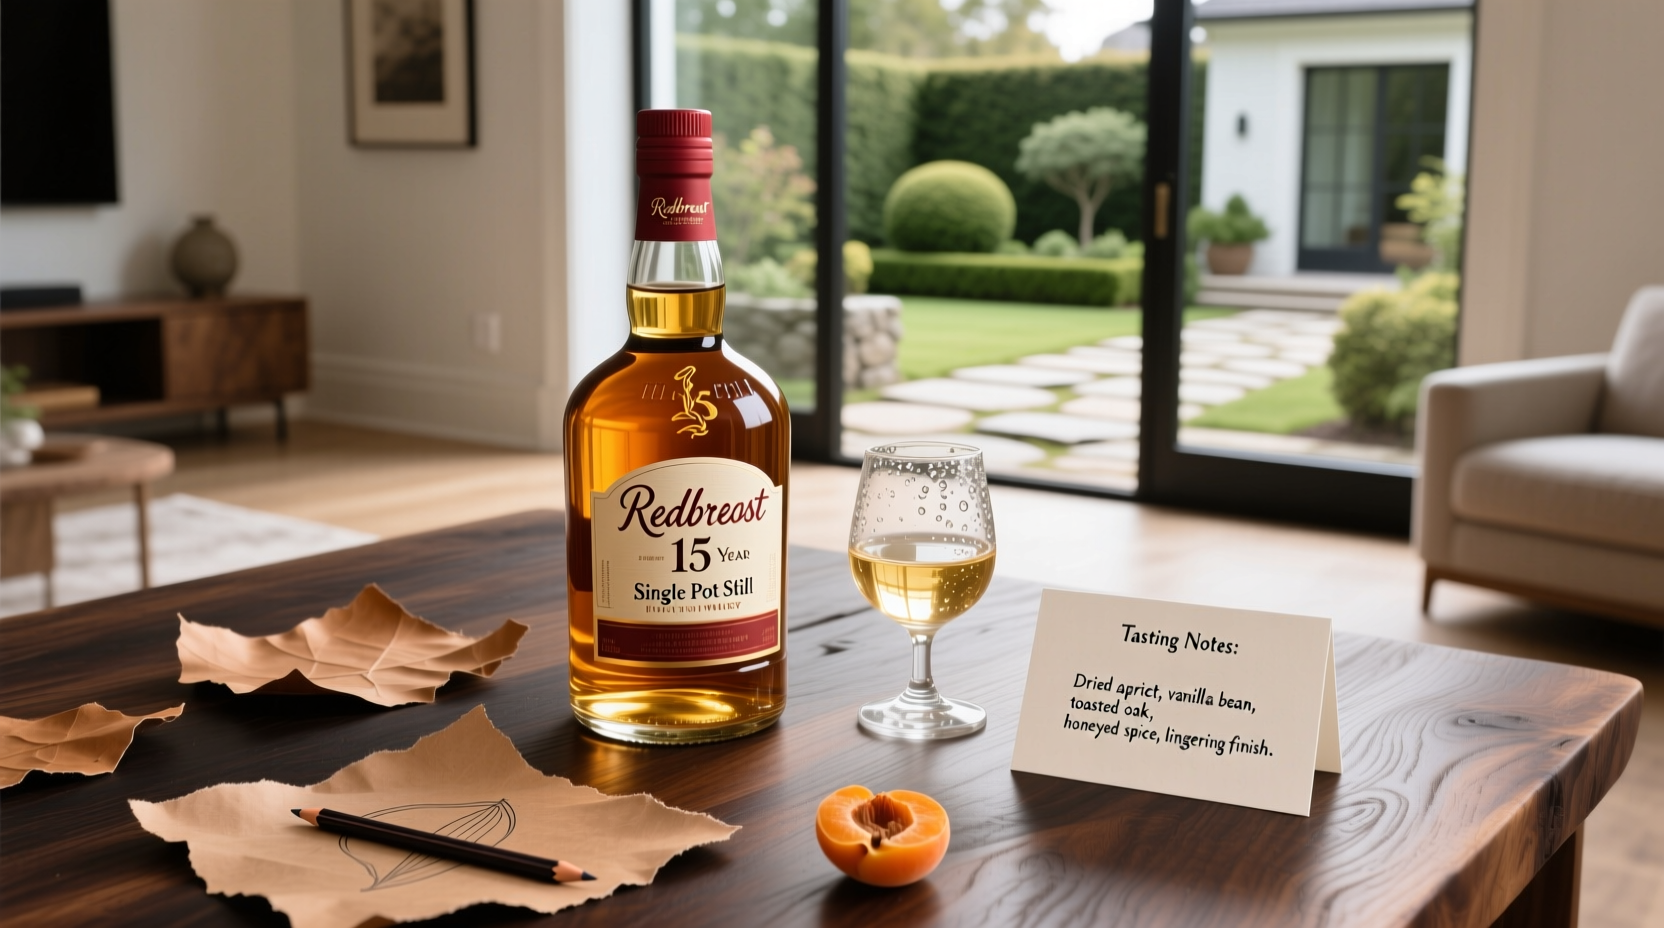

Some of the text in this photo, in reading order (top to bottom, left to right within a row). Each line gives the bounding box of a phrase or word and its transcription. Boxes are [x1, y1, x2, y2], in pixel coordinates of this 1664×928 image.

[671, 536, 711, 573] 15
[634, 582, 686, 606] Single
[691, 582, 720, 600] Pot
[723, 576, 754, 597] Still
[1121, 623, 1240, 655] Tasting Notes:
[1070, 696, 1154, 722] toasted oak,
[1073, 672, 1114, 692] Dried
[1167, 687, 1214, 706] vanilla
[1218, 690, 1257, 714] bean,
[1063, 713, 1274, 757] honeyed spice, lingering finish.
